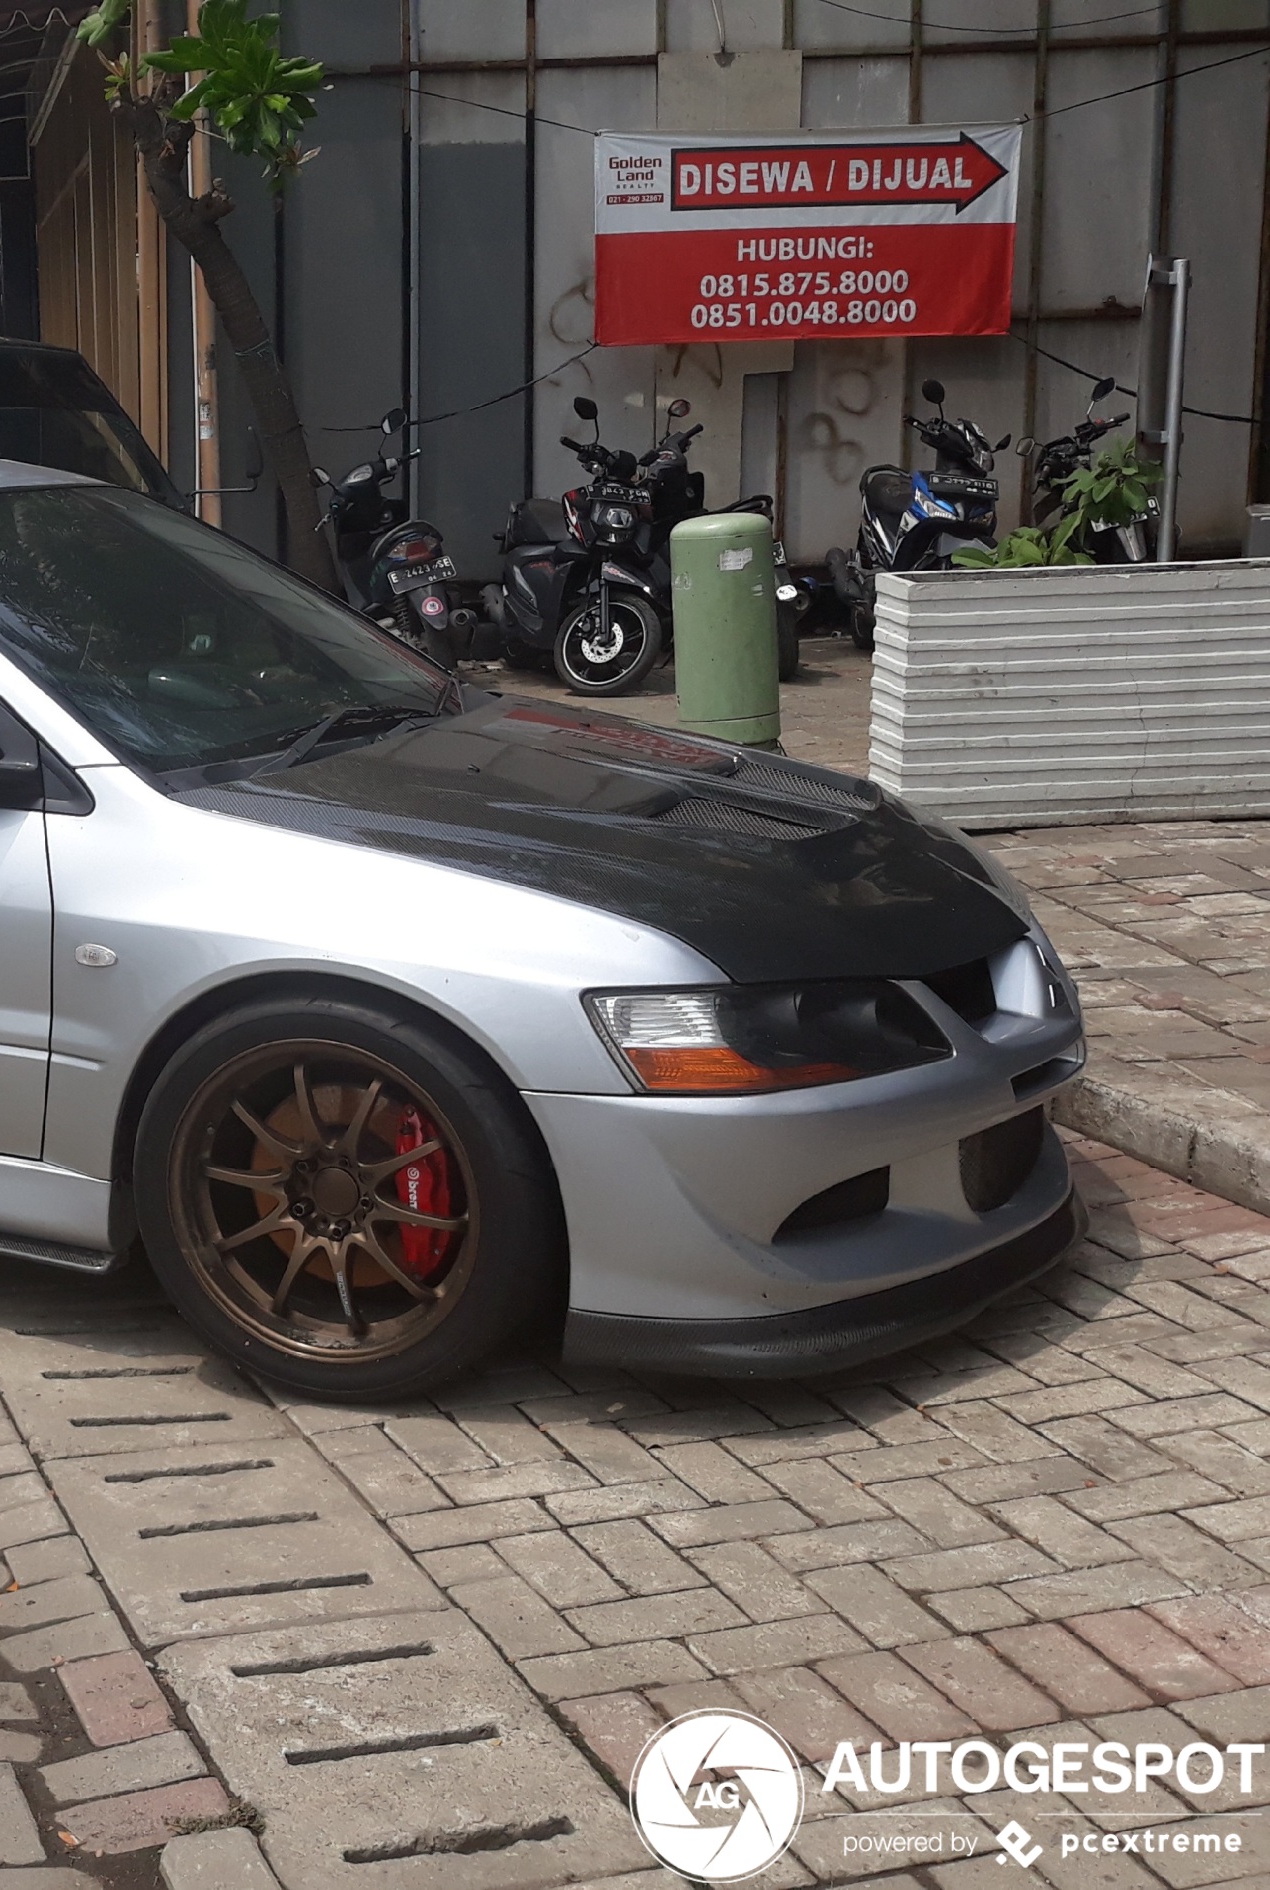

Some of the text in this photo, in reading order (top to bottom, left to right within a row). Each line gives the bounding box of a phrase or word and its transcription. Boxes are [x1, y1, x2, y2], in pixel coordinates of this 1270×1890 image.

[609, 156, 662, 169] Golden
[617, 170, 654, 181] Land
[680, 157, 973, 196] DISEWA / DIJUAL
[737, 237, 874, 262] HUBUNGI:
[700, 269, 909, 298] 0815.875.8000
[691, 299, 917, 328] 0851.0048.8000
[391, 573, 398, 583] E
